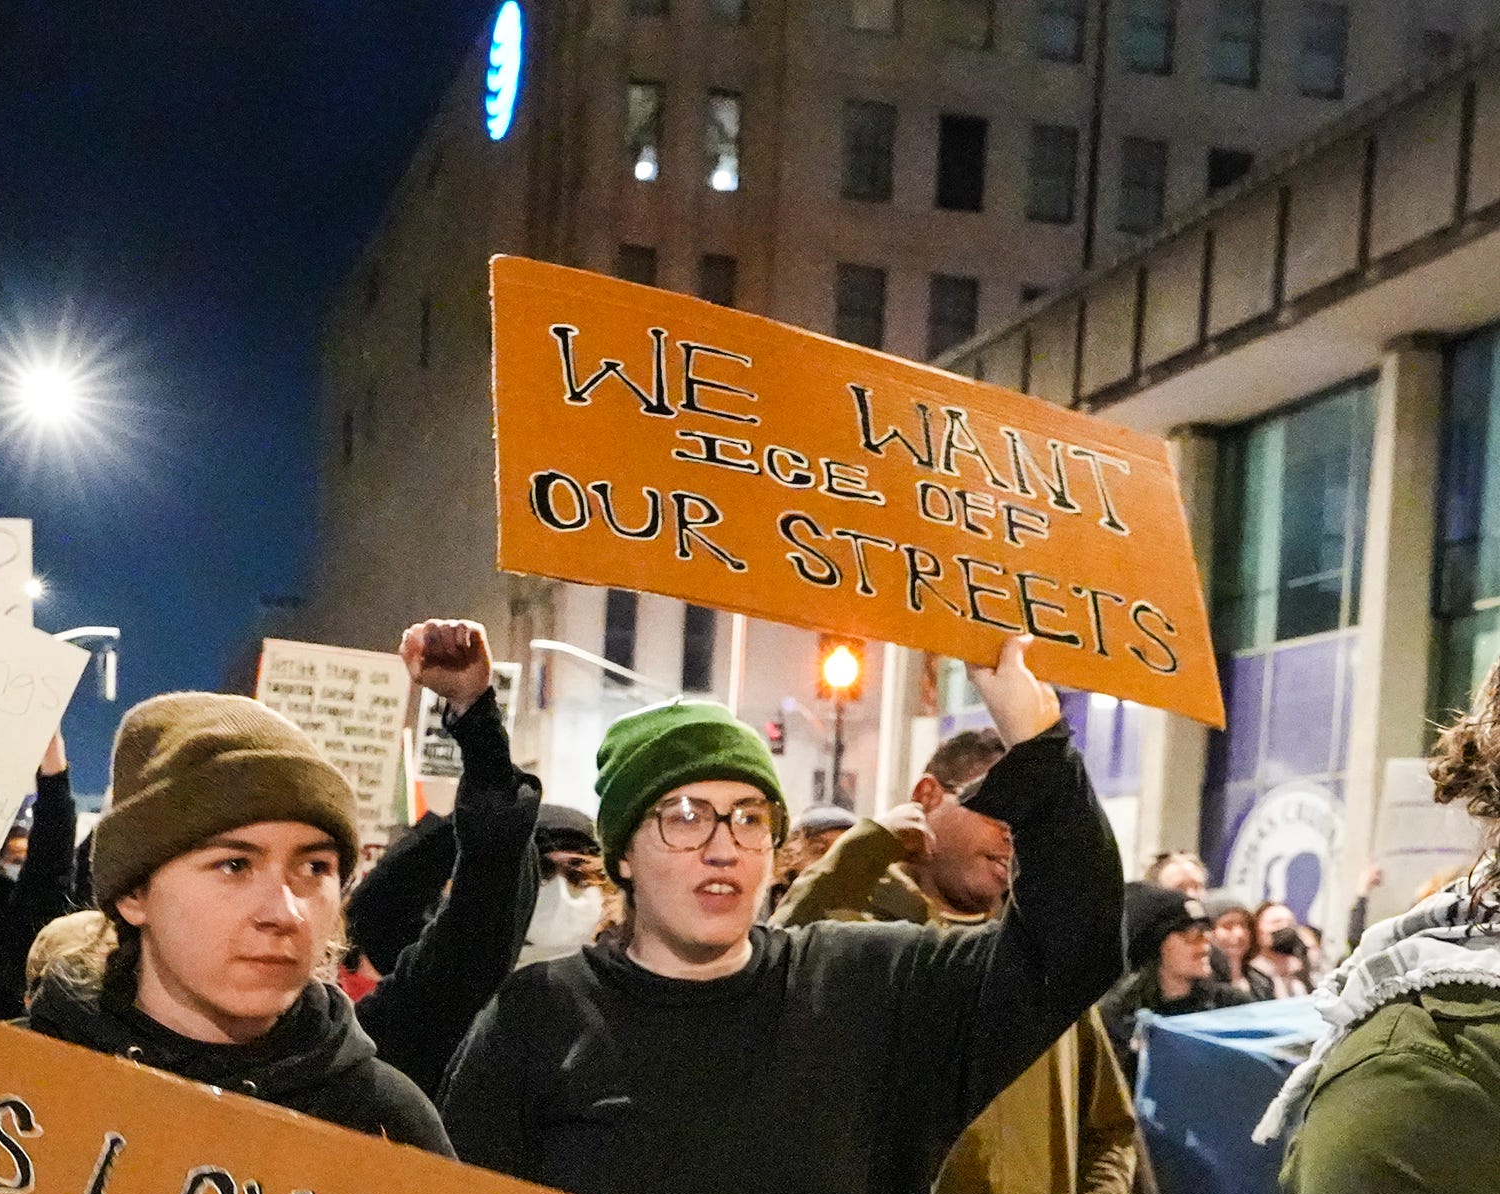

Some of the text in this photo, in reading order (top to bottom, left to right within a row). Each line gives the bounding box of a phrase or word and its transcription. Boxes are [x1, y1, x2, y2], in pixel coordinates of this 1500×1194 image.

[548, 323, 1133, 537] WE WANT
[670, 428, 1052, 549] ICE OFF
[527, 468, 1180, 678] OUR STREETS
